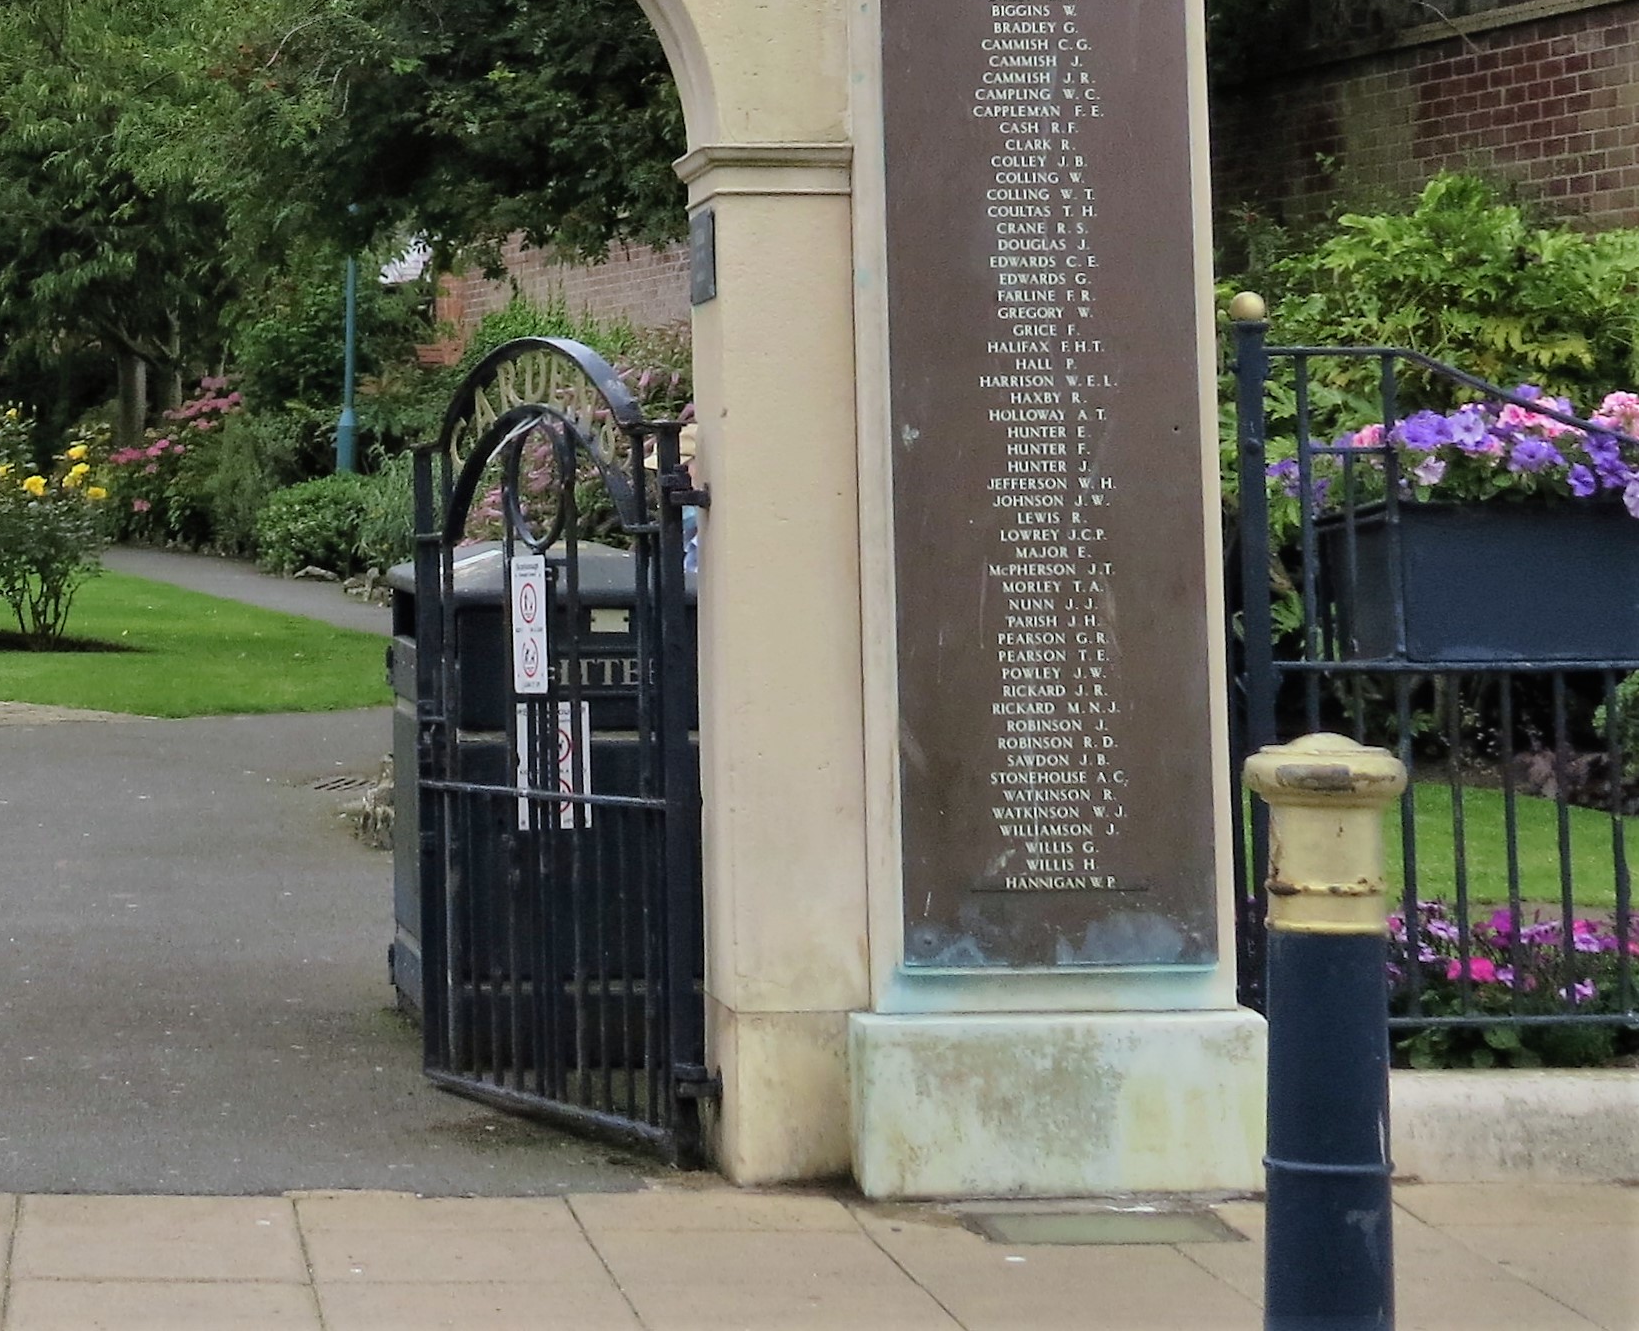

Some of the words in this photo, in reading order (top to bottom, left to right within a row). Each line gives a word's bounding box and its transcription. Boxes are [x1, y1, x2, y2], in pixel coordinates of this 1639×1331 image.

[992, 5, 1050, 16] BIGGINS
[994, 22, 1056, 33] BRADLEY
[982, 39, 1048, 50] CAMMISH
[989, 56, 1056, 67] CAMMISH
[983, 72, 1050, 83] CAMMISH
[975, 89, 1051, 100] CAMPLING
[973, 106, 1060, 117] CAPPLEMAN
[1000, 122, 1038, 133] CASH
[1005, 139, 1051, 150] CLARK
[991, 156, 1045, 167] COLLEY
[996, 172, 1058, 183] COLLING
[987, 189, 1049, 200] COLLING
[988, 206, 1050, 217] COULTAS
[997, 223, 1045, 234] CRANE
[998, 239, 1066, 250] DOUGLAS
[990, 256, 1056, 267] EDWARDS
[1000, 273, 1065, 285] EDWARDS
[998, 290, 1055, 301] FARLINE
[998, 307, 1064, 318] GREGORY
[1013, 325, 1057, 336] GRICE
[988, 341, 1049, 353] HALIFAX
[1016, 359, 1052, 370] HALL
[980, 376, 1054, 387] HARRISON
[1011, 392, 1061, 403] HAXBY
[989, 410, 1064, 421] HOLLOWAY
[1008, 426, 1066, 438] HUNTER
[1008, 443, 1066, 455] HUNTER
[1008, 461, 1066, 472] HUNTER
[987, 478, 1067, 490] JEFFERSON
[993, 495, 1063, 507] JOHNSON
[1018, 512, 1059, 524] LEWIS
[1001, 529, 1059, 541] LOWREY
[1016, 547, 1068, 558] MAJOR
[1003, 581, 1061, 592] MORLEY
[1009, 599, 1054, 610] NUNN
[998, 633, 1065, 644] PEARSON
[999, 650, 1066, 662] PEARSON
[1002, 667, 1060, 679] POWLEY
[1003, 685, 1065, 697] RICKARD
[993, 703, 1054, 714] RICKARD
[1007, 720, 1081, 731] ROBINSON
[998, 737, 1073, 749] ROBINSON
[1008, 755, 1069, 766] SAWDON
[991, 772, 1086, 784] STONEHOUSE
[1003, 790, 1090, 801] WATKINSON
[992, 807, 1079, 819] WATKINSON
[1000, 824, 1093, 836] WILLIAMSON
[1026, 859, 1074, 871] WILLIS
[1006, 877, 1086, 888] HANNIGAN
